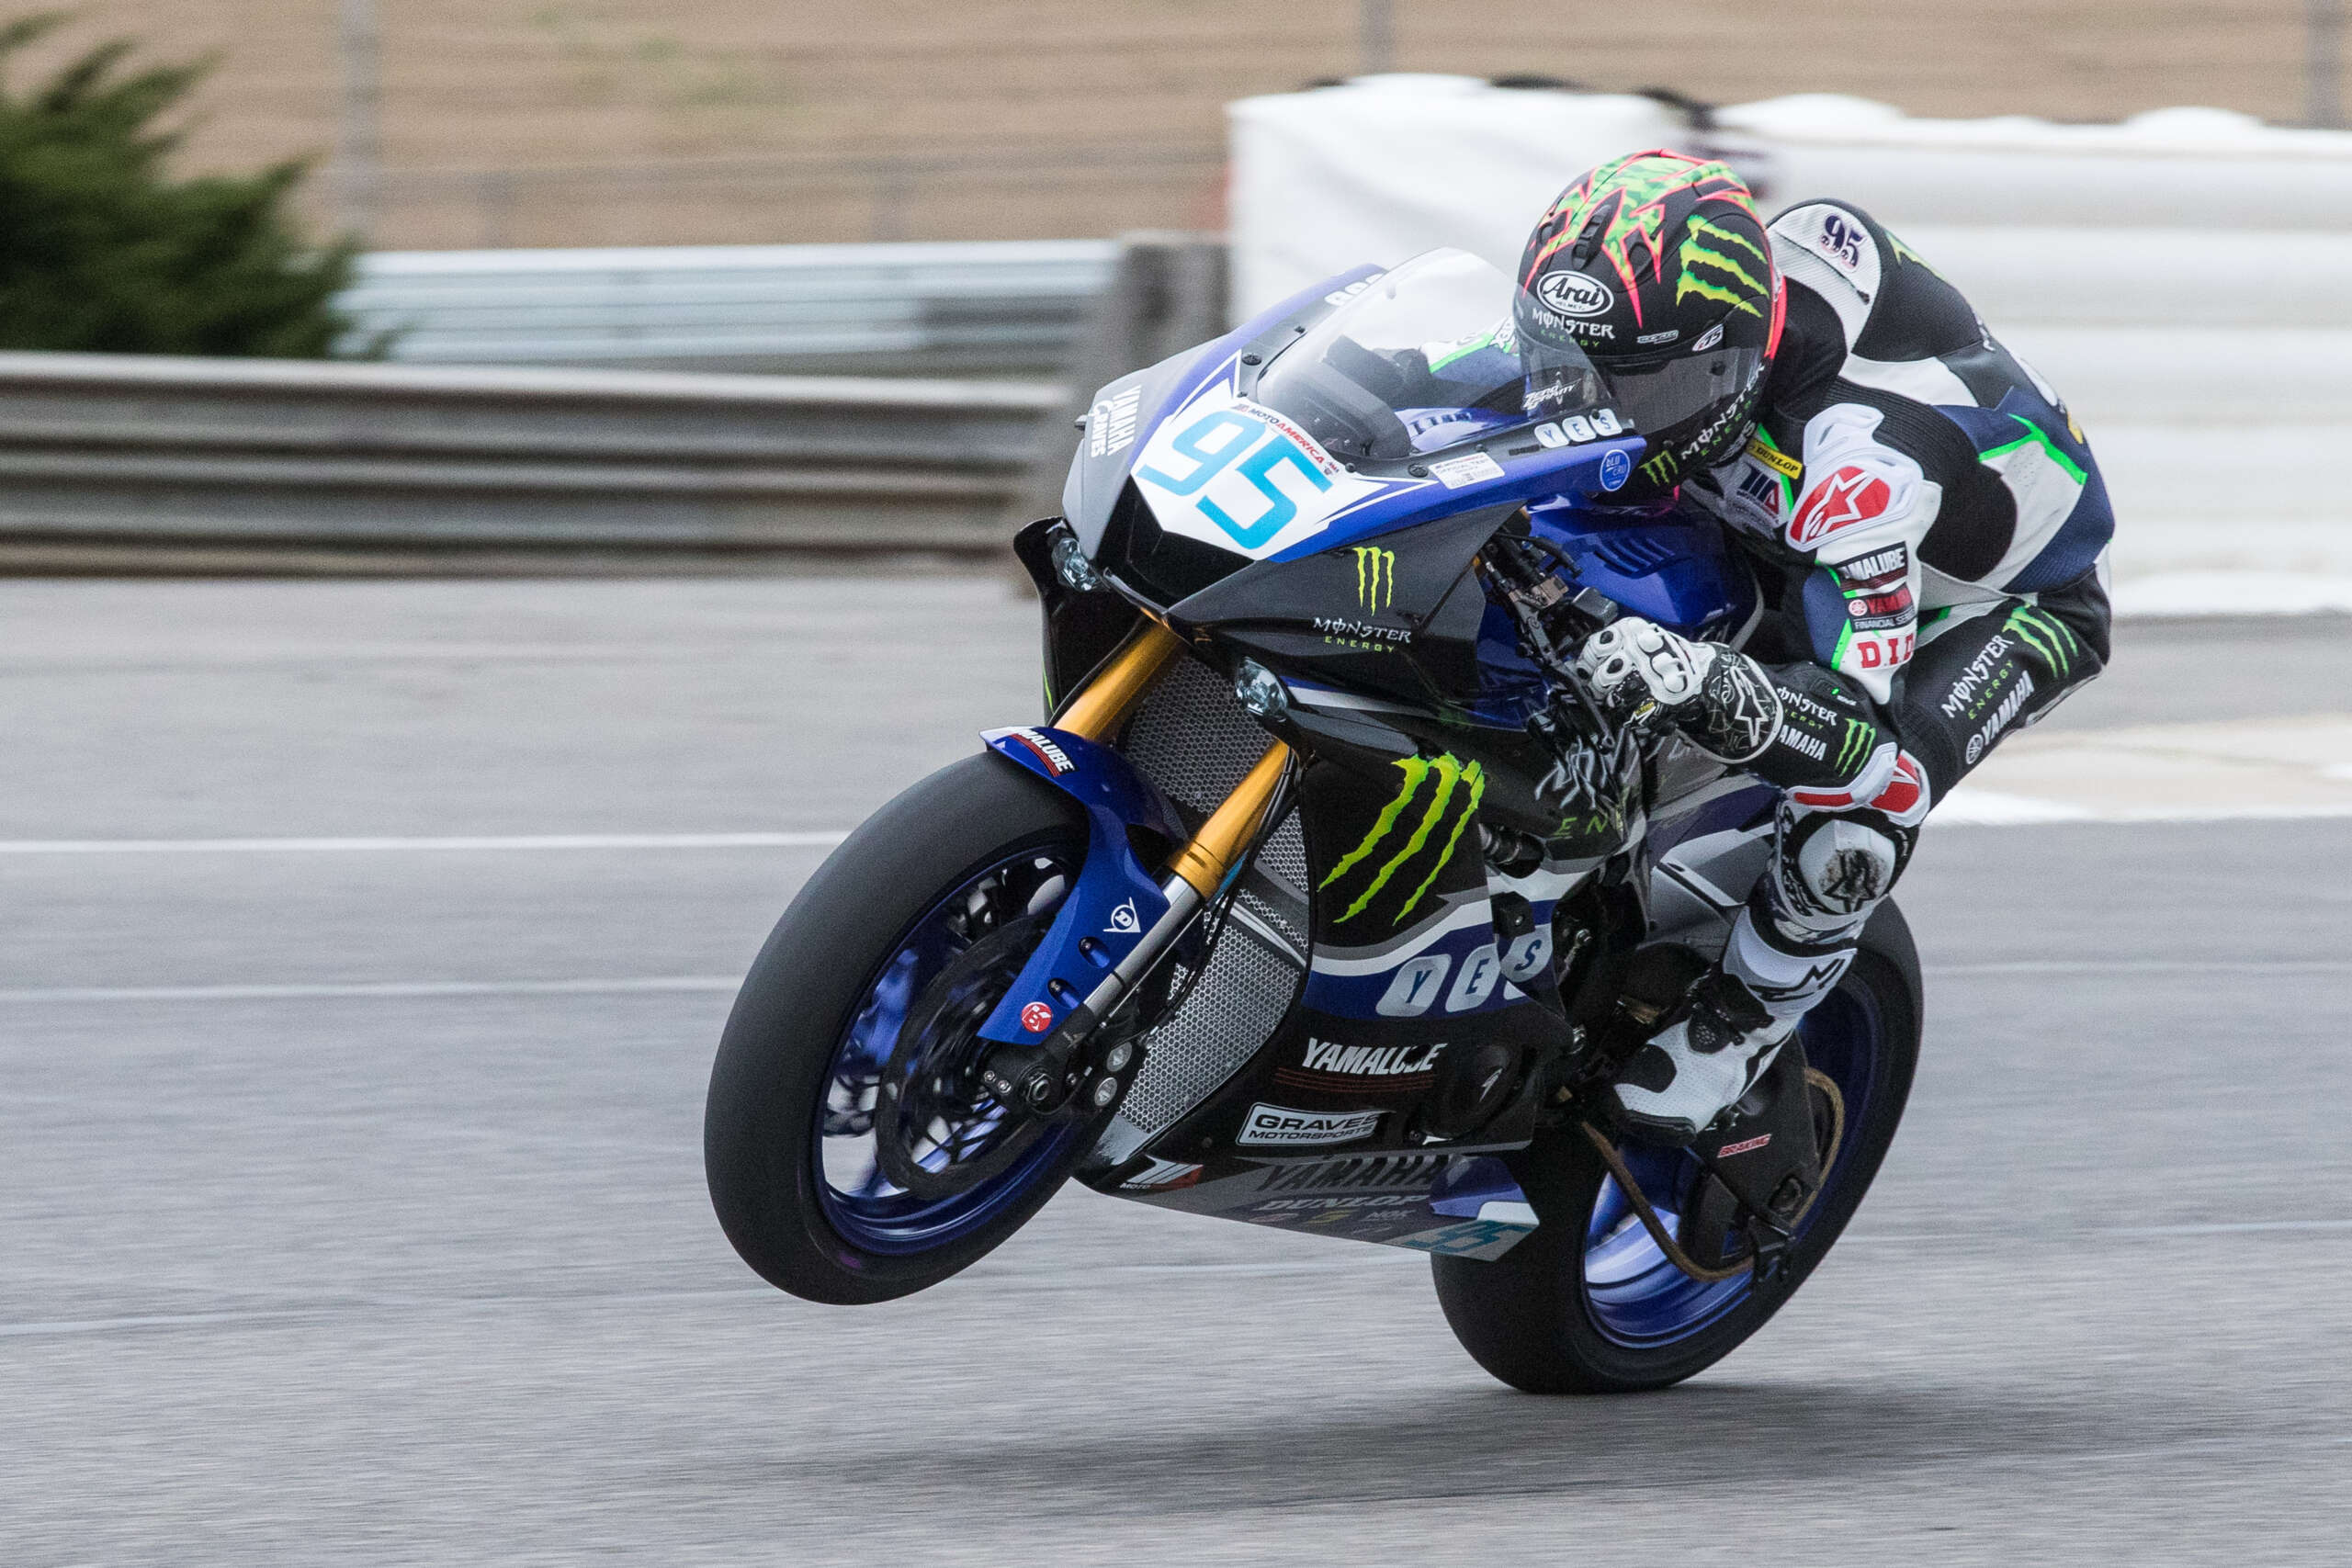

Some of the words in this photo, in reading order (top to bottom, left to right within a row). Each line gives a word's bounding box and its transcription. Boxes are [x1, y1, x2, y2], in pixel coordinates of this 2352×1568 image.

[1820, 214, 1864, 268] 95
[1543, 276, 1601, 306] Arai
[1532, 308, 1615, 340] MONSTER
[1107, 385, 1142, 456] YAMAHA
[1756, 446, 1799, 472] DUNLOP
[1136, 410, 1334, 550] 95
[1313, 617, 1411, 643] MONSTER
[1324, 636, 1395, 653] ENERGY
[1941, 635, 2014, 718] MONSTER
[1968, 660, 2013, 720] ENERGY
[1777, 686, 1838, 726] ONSTER
[1982, 670, 2034, 746] YAMAHA
[1779, 724, 1827, 761] AMAHA
[1249, 1124, 1374, 1140] MOTORSPORTS
[1254, 1113, 1379, 1131] GRAVES
